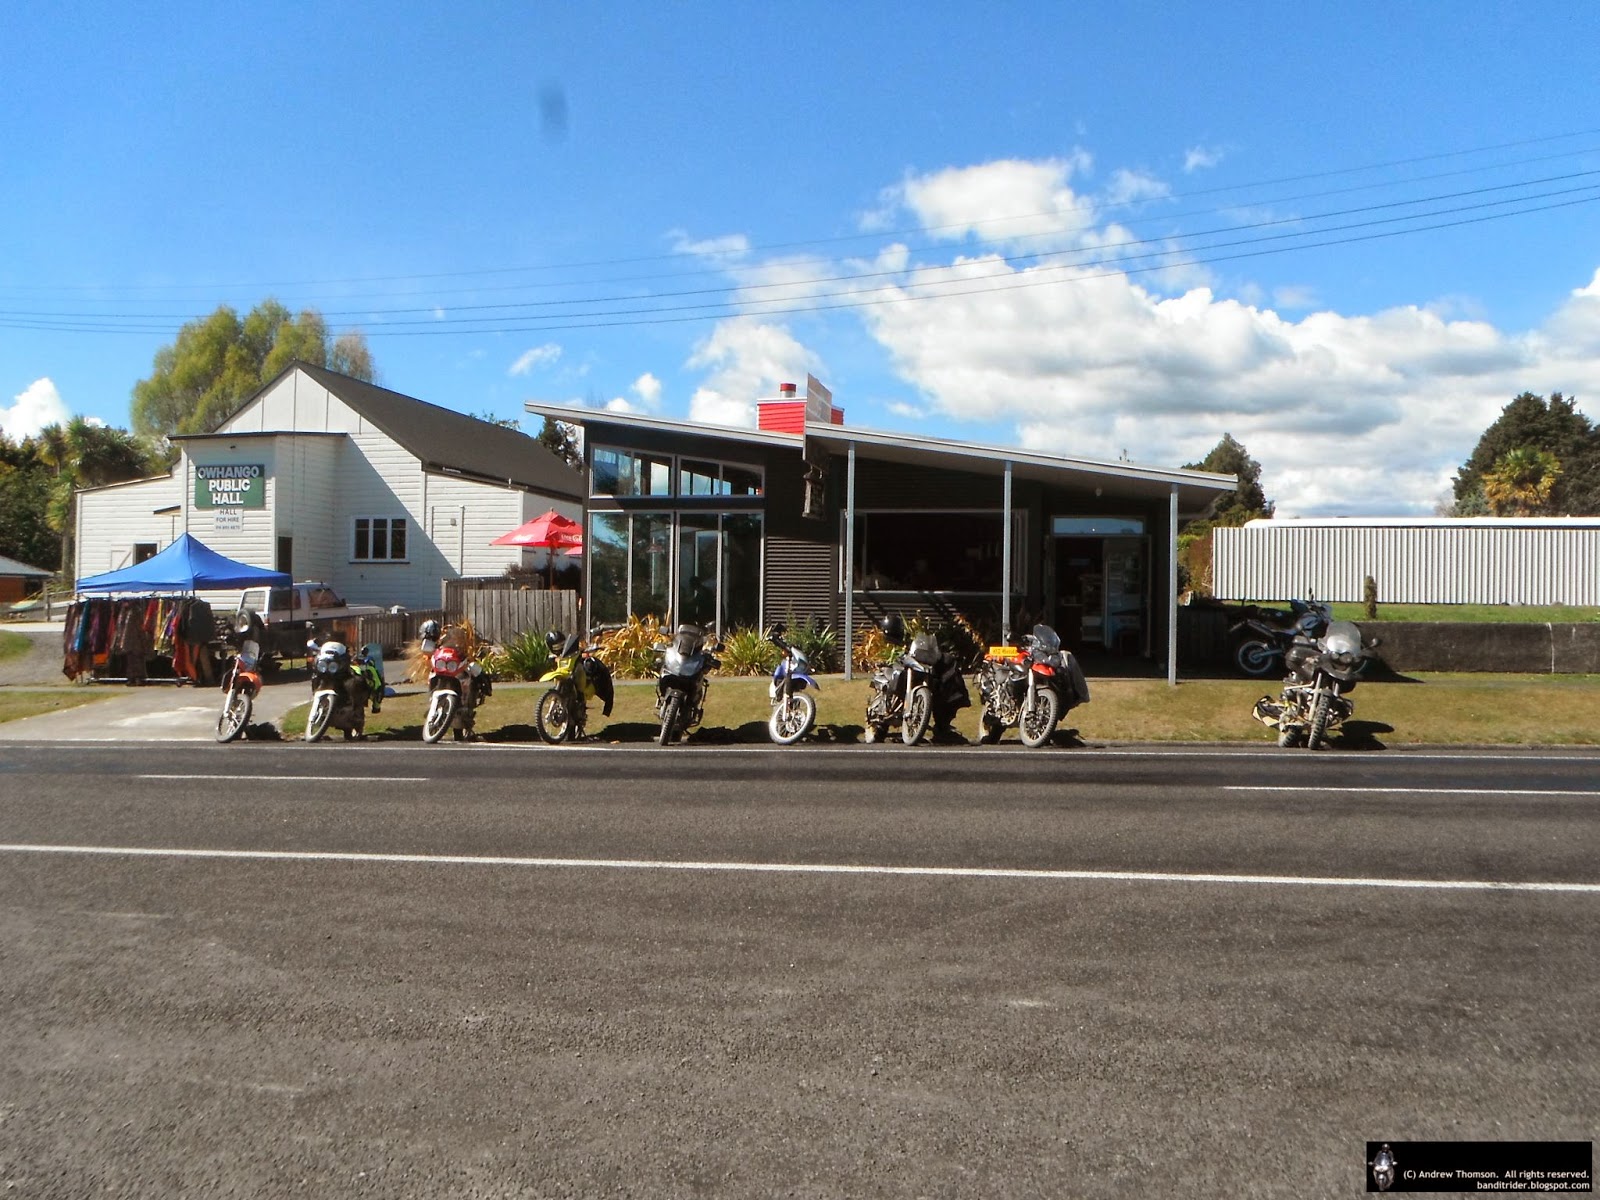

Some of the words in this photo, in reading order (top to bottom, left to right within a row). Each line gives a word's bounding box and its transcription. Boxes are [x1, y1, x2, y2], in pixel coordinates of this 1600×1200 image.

[198, 466, 260, 479] OWHANGO
[208, 479, 251, 492] PUBLIC
[212, 492, 244, 505] HALL
